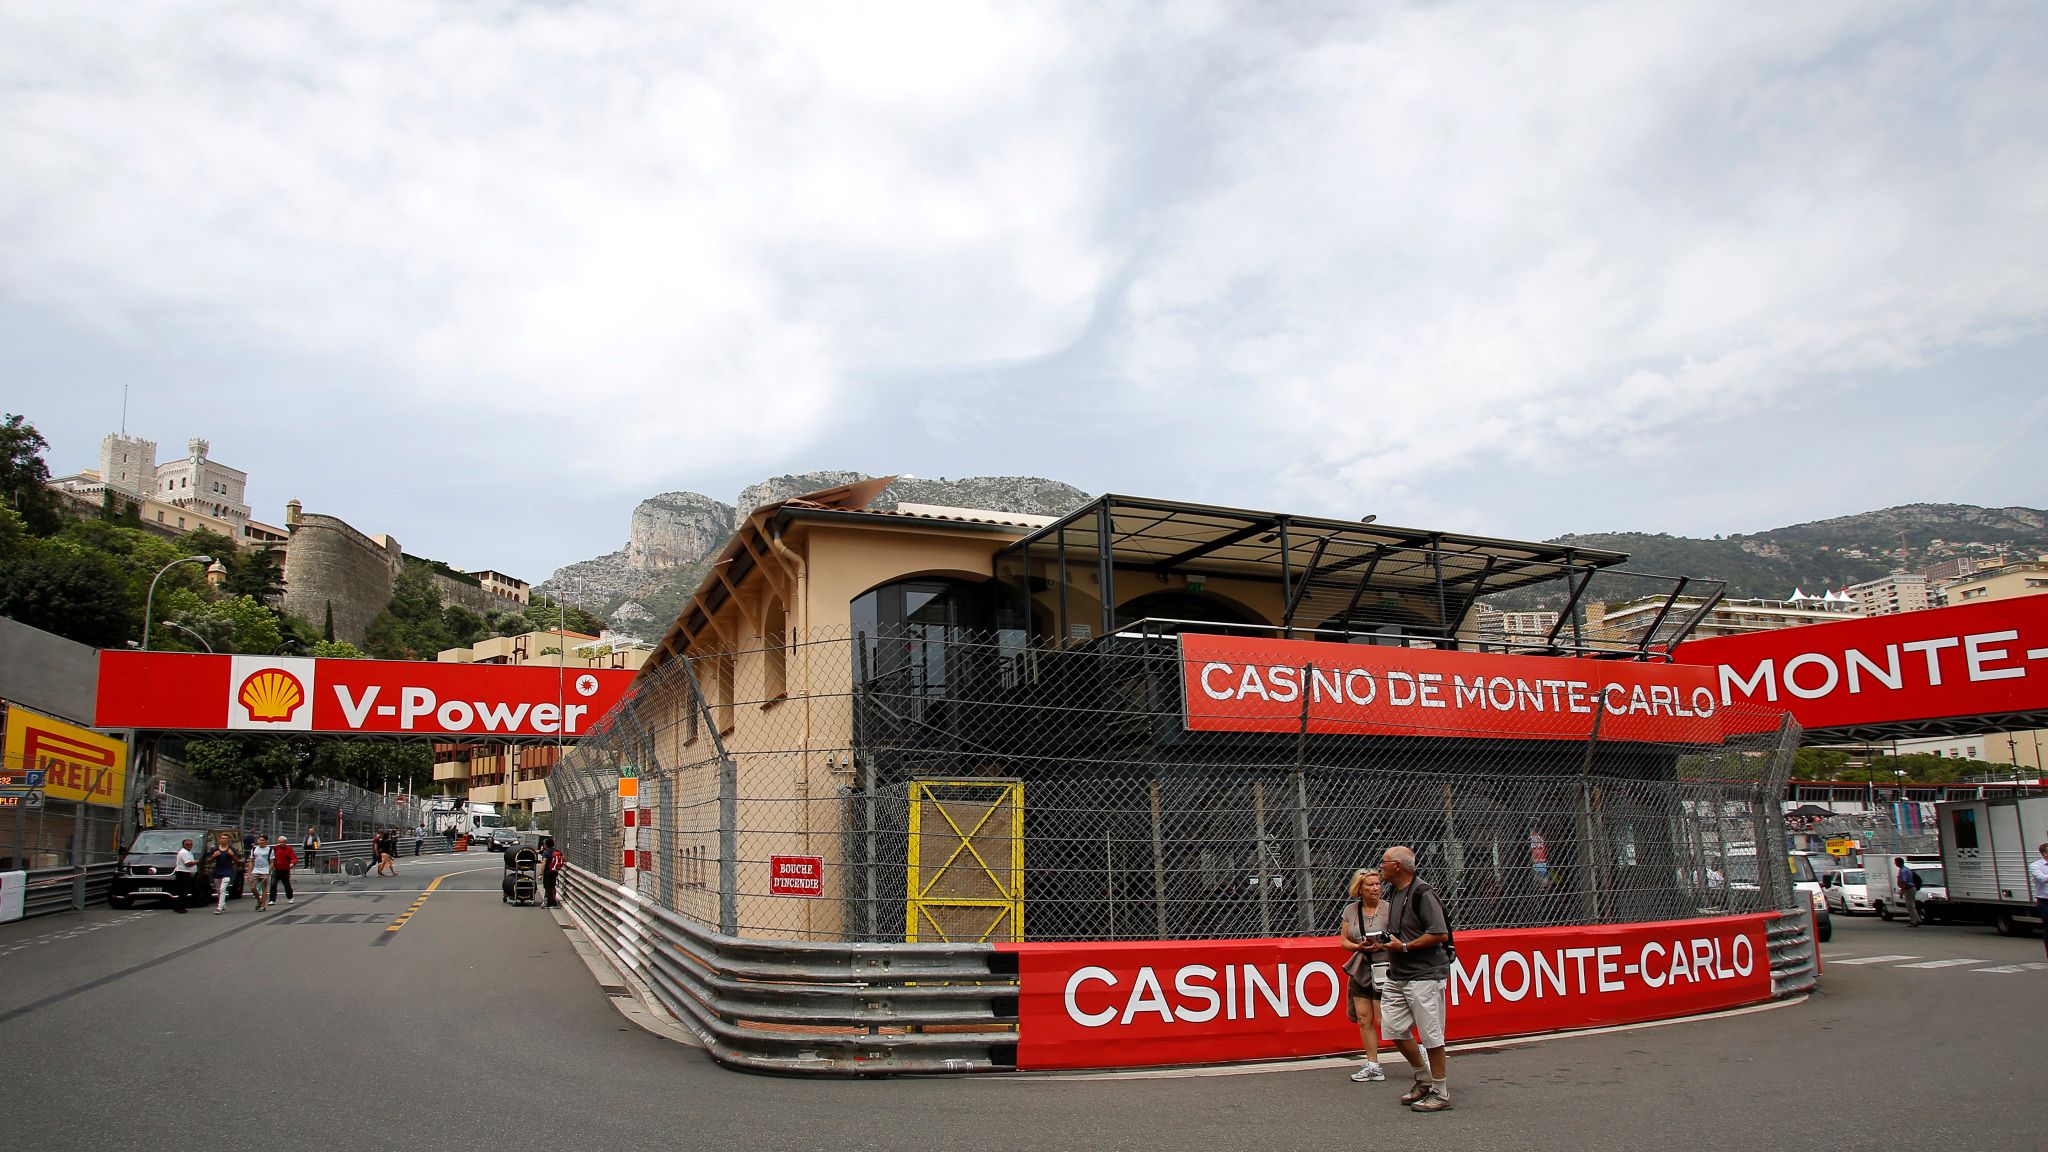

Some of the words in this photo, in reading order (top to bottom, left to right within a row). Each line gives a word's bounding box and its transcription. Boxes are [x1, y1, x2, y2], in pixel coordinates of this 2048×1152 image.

[332, 684, 589, 733] V-Power
[1200, 661, 1377, 706] CASINO
[1387, 671, 1446, 708] DE
[1453, 674, 1715, 719] MONTE-CARLO
[773, 877, 819, 889] D'INCENDIE
[779, 863, 813, 875] BOUCHE
[1064, 960, 1341, 1028] CASINO
[1450, 932, 1754, 1007] MONTE-CARLO
